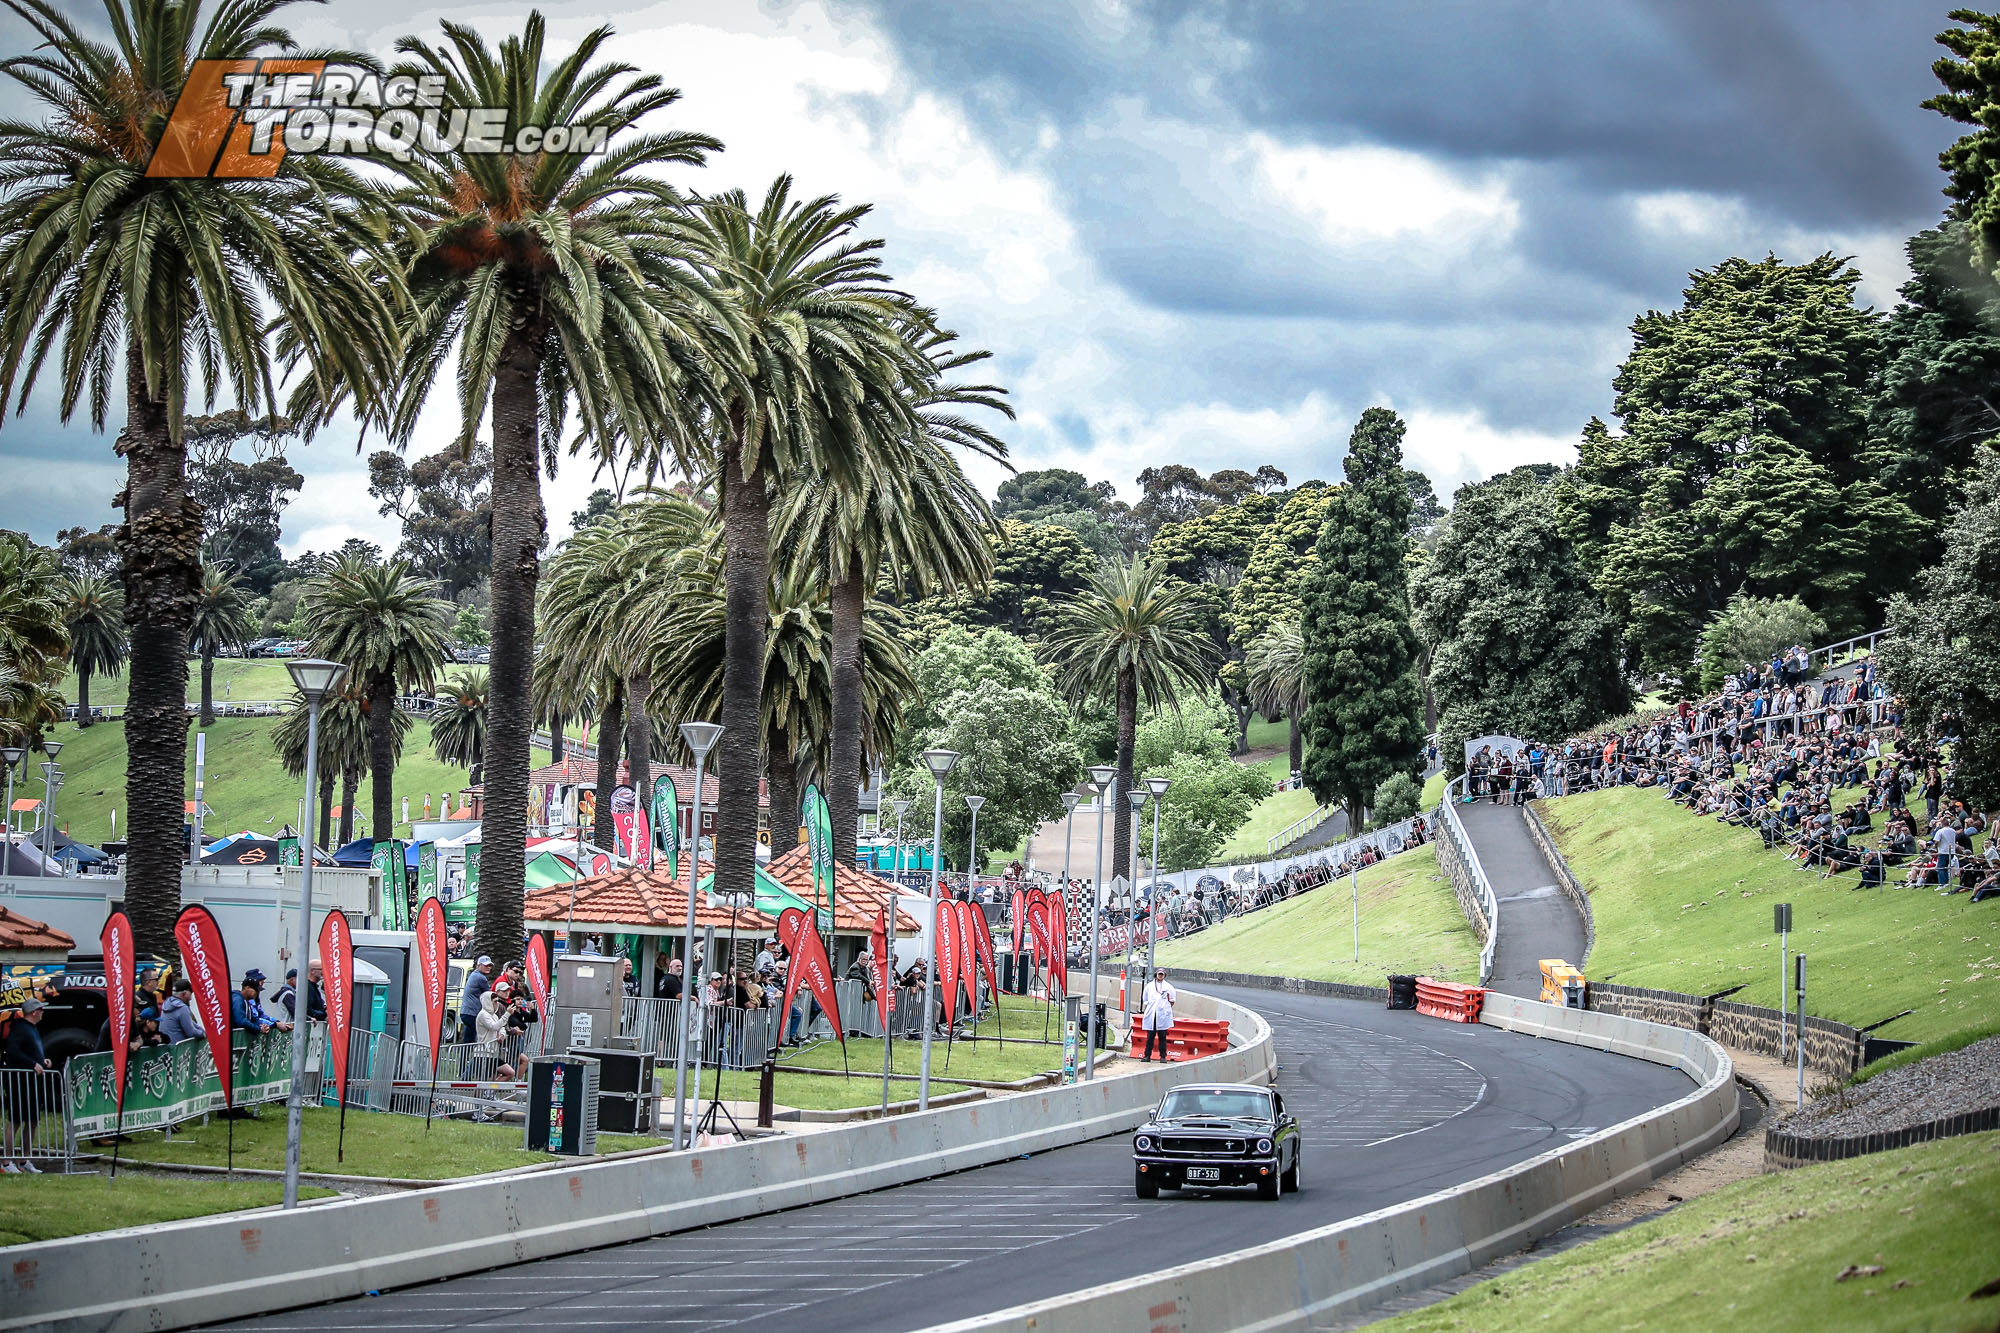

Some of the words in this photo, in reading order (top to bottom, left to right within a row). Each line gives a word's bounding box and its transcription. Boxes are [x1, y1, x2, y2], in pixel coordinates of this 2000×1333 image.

[660, 799, 676, 852] SHANNONS
[427, 907, 437, 960] GEELONG
[941, 907, 951, 946] GEELONG
[958, 907, 968, 944] GEELONG
[1069, 881, 1081, 944] START
[111, 927, 122, 986] GEELONG
[330, 920, 341, 978] GEELONG
[944, 946, 953, 984] REVIVAL
[962, 941, 972, 975] REVIVAL
[64, 976, 108, 987] NULO
[188, 922, 211, 980] GEELONG
[204, 981, 227, 1036] REVIVAL
[429, 960, 440, 1009] REVIVAL
[334, 978, 345, 1033] REVIVAL
[125, 1113, 135, 1127] THE
[136, 1110, 162, 1125] PASSION
